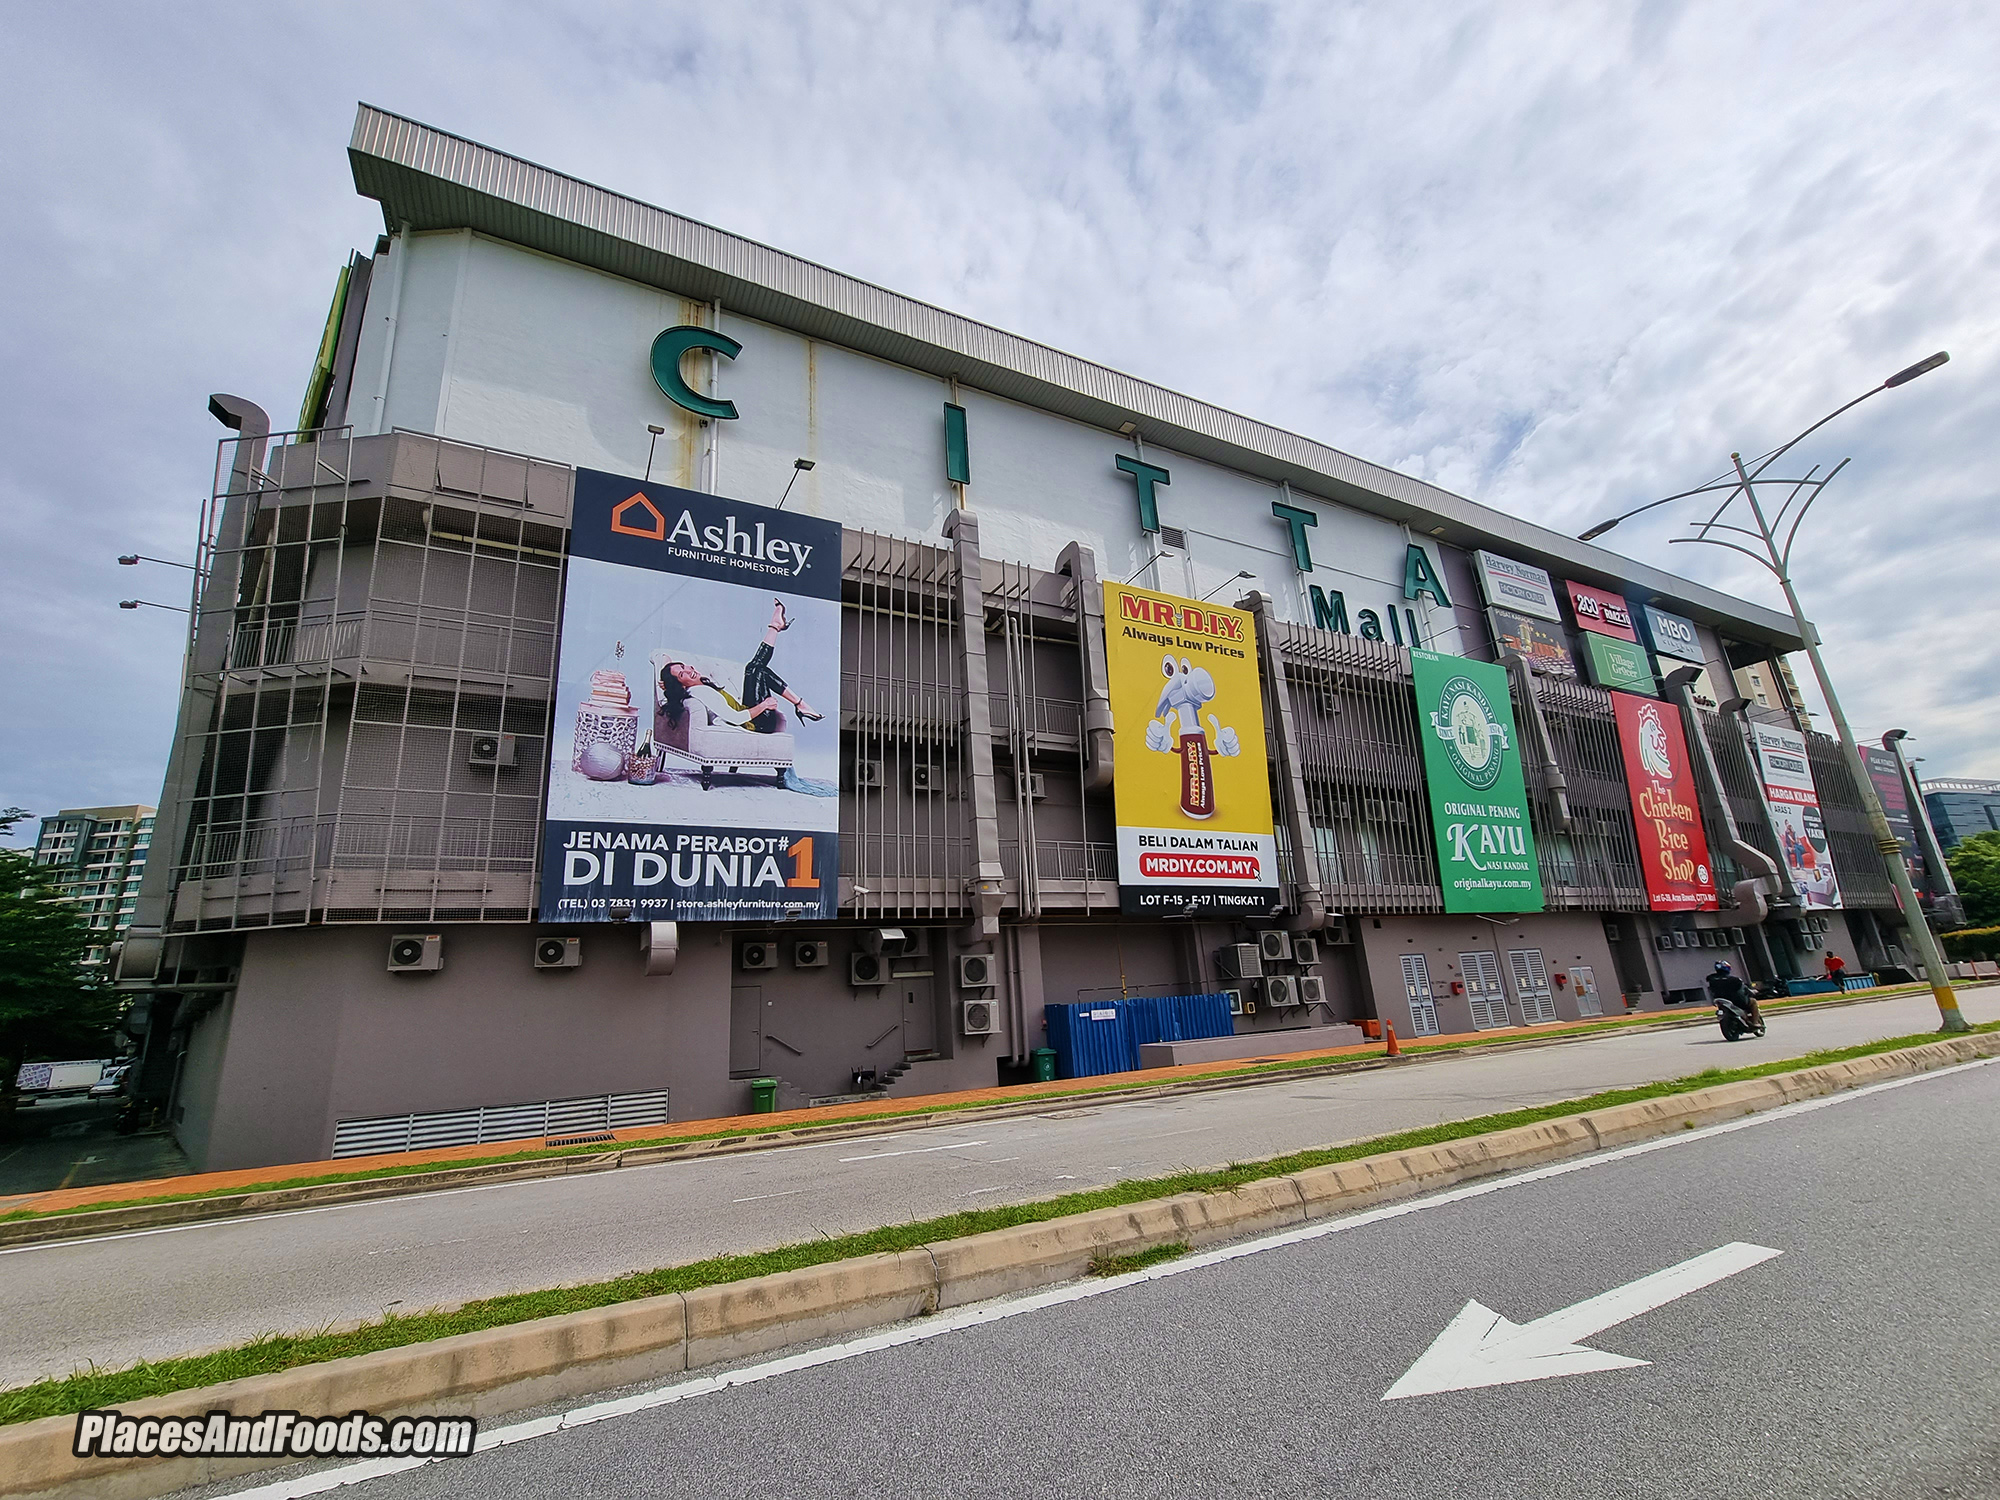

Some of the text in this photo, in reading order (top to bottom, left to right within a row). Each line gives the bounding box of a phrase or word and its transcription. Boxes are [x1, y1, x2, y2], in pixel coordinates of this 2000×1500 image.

[666, 509, 813, 577] Ashley
[668, 546, 790, 577] FURNITURE HOMESTORE
[1484, 555, 1548, 583] Harvey Norman
[1309, 584, 1421, 648] Mall
[1604, 608, 1631, 625] RM2.10
[1656, 615, 1692, 642] MBO
[1121, 626, 1245, 659] Always Low Prices
[1412, 650, 1440, 661] RESTORAN
[1609, 652, 1635, 670] Village
[1611, 663, 1638, 679] Grocer
[1466, 682, 1494, 721] KANDAR
[1451, 747, 1500, 783] ORIGINAL PENANG
[1651, 779, 1667, 795] The
[1769, 787, 1817, 804] HARGA KILANG
[1444, 802, 1521, 819] ORIGINAL PENANG
[1639, 787, 1693, 821] Chicken
[562, 831, 669, 851] JENAMA
[1138, 834, 1259, 851] BELI DALAM TALIAN
[1653, 818, 1689, 850] Rice
[1446, 823, 1526, 871] KAYU
[563, 850, 785, 888] DI DUNIA
[1145, 857, 1252, 875] MRDIY.COM.MY
[1486, 861, 1530, 871] NASI KANDAR
[1453, 878, 1532, 891] originalkayu.com.my
[558, 898, 588, 910] (TEL)
[591, 898, 605, 909] 03
[609, 899, 637, 909] 7831
[640, 899, 668, 909] 9937
[676, 899, 820, 911] store.ashleyfurniture.com.my
[1140, 895, 1161, 906] LOT
[1163, 895, 1183, 906] F-15
[1192, 895, 1210, 906] F-17
[1218, 895, 1258, 906] TINGKAT
